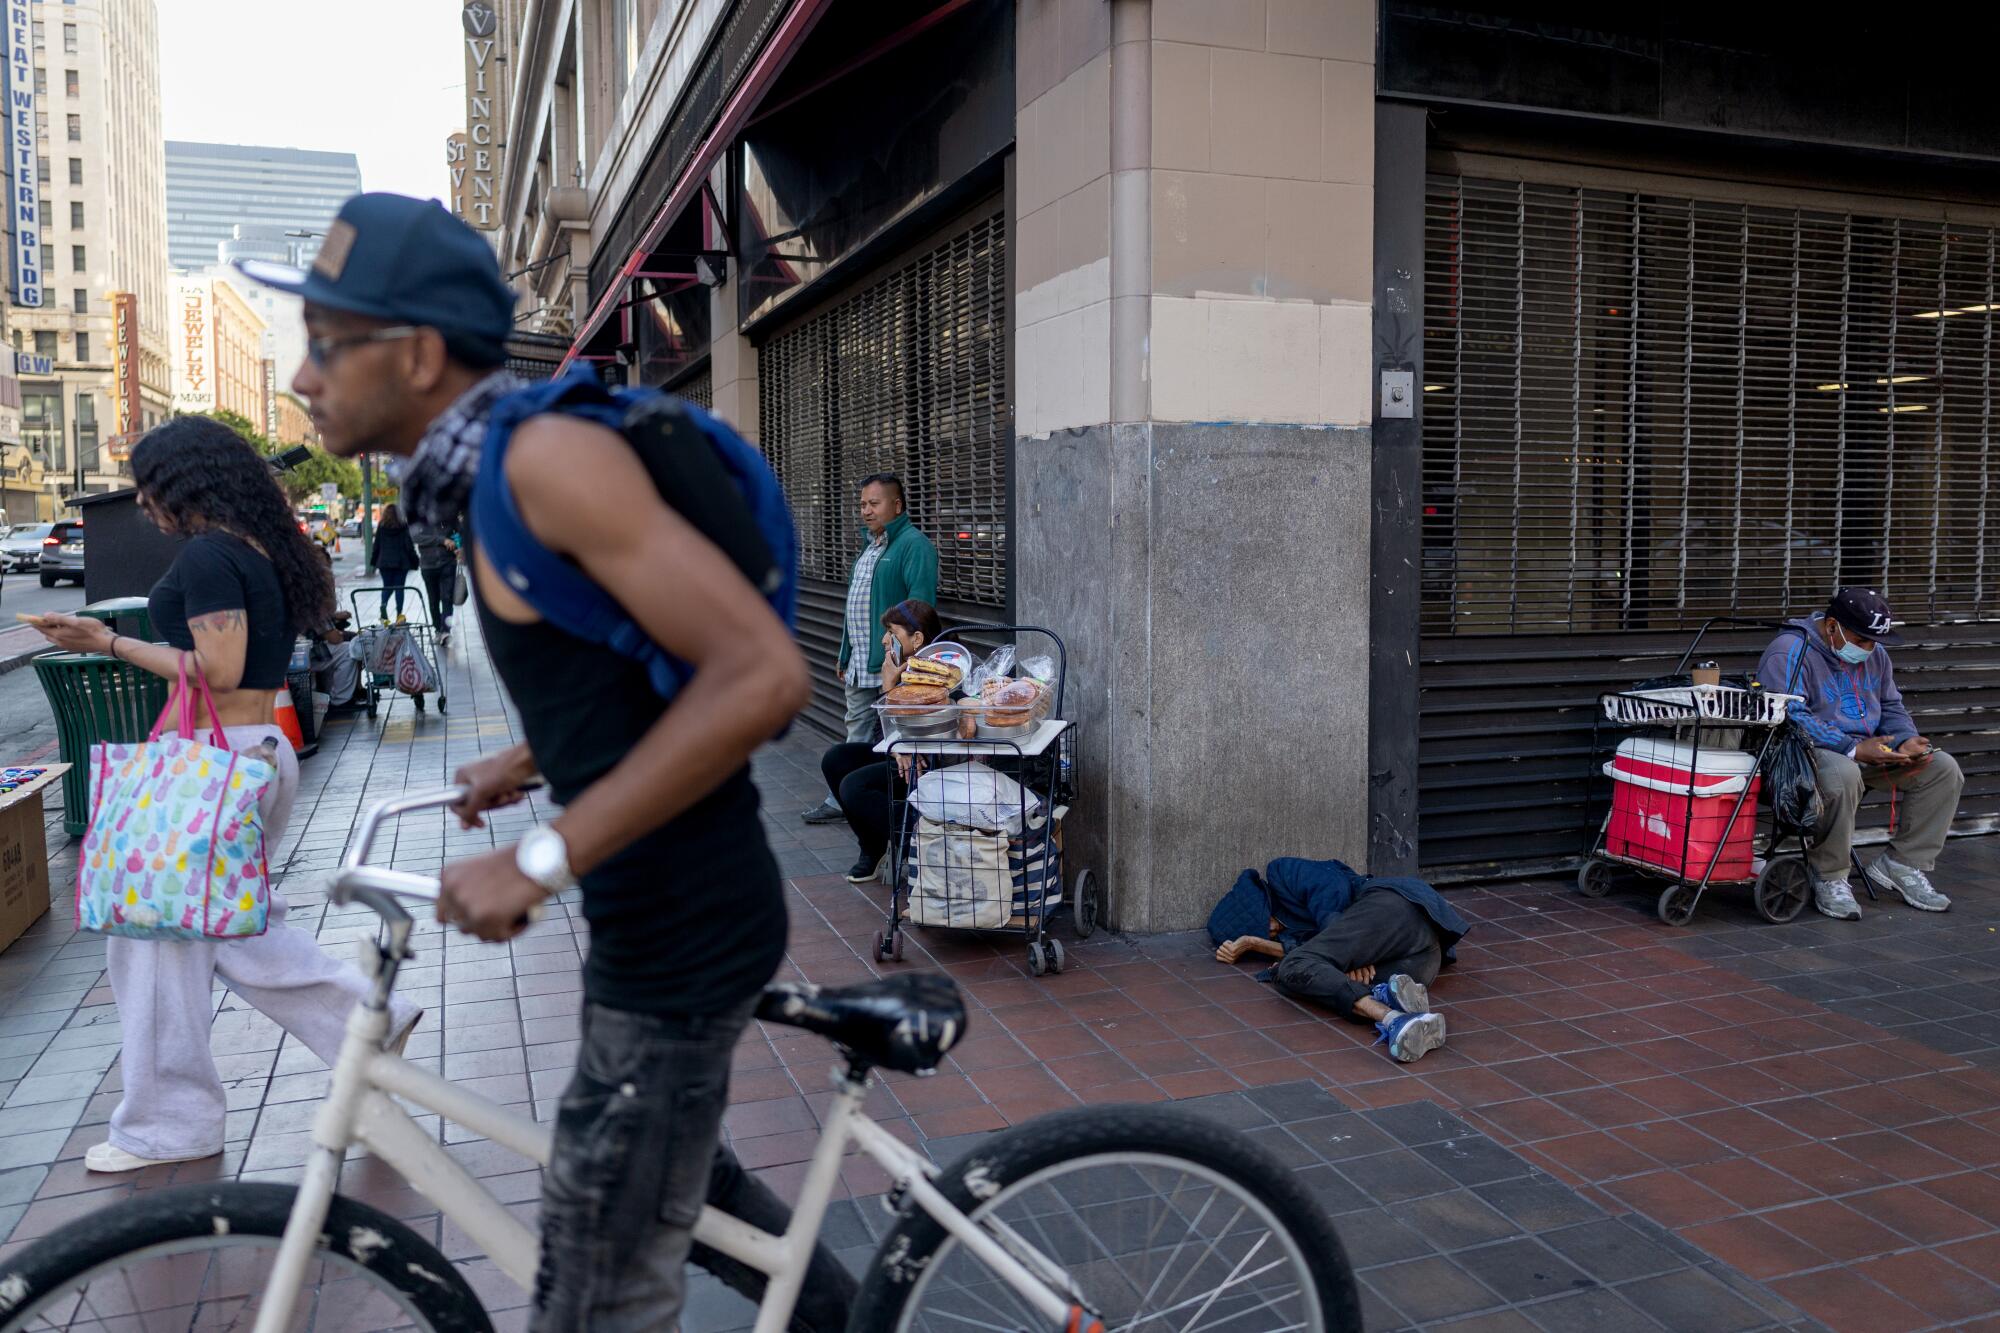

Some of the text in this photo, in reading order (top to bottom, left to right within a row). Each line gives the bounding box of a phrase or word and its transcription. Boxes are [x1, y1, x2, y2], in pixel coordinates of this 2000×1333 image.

[13, 90, 34, 222] WESTERN
[467, 38, 494, 225] VINCENT
[21, 230, 38, 304] BLDG
[117, 308, 131, 433] JEWELRY
[182, 296, 206, 391] JEWELRY
[180, 393, 212, 402] MART
[1868, 613, 1891, 634] LA
